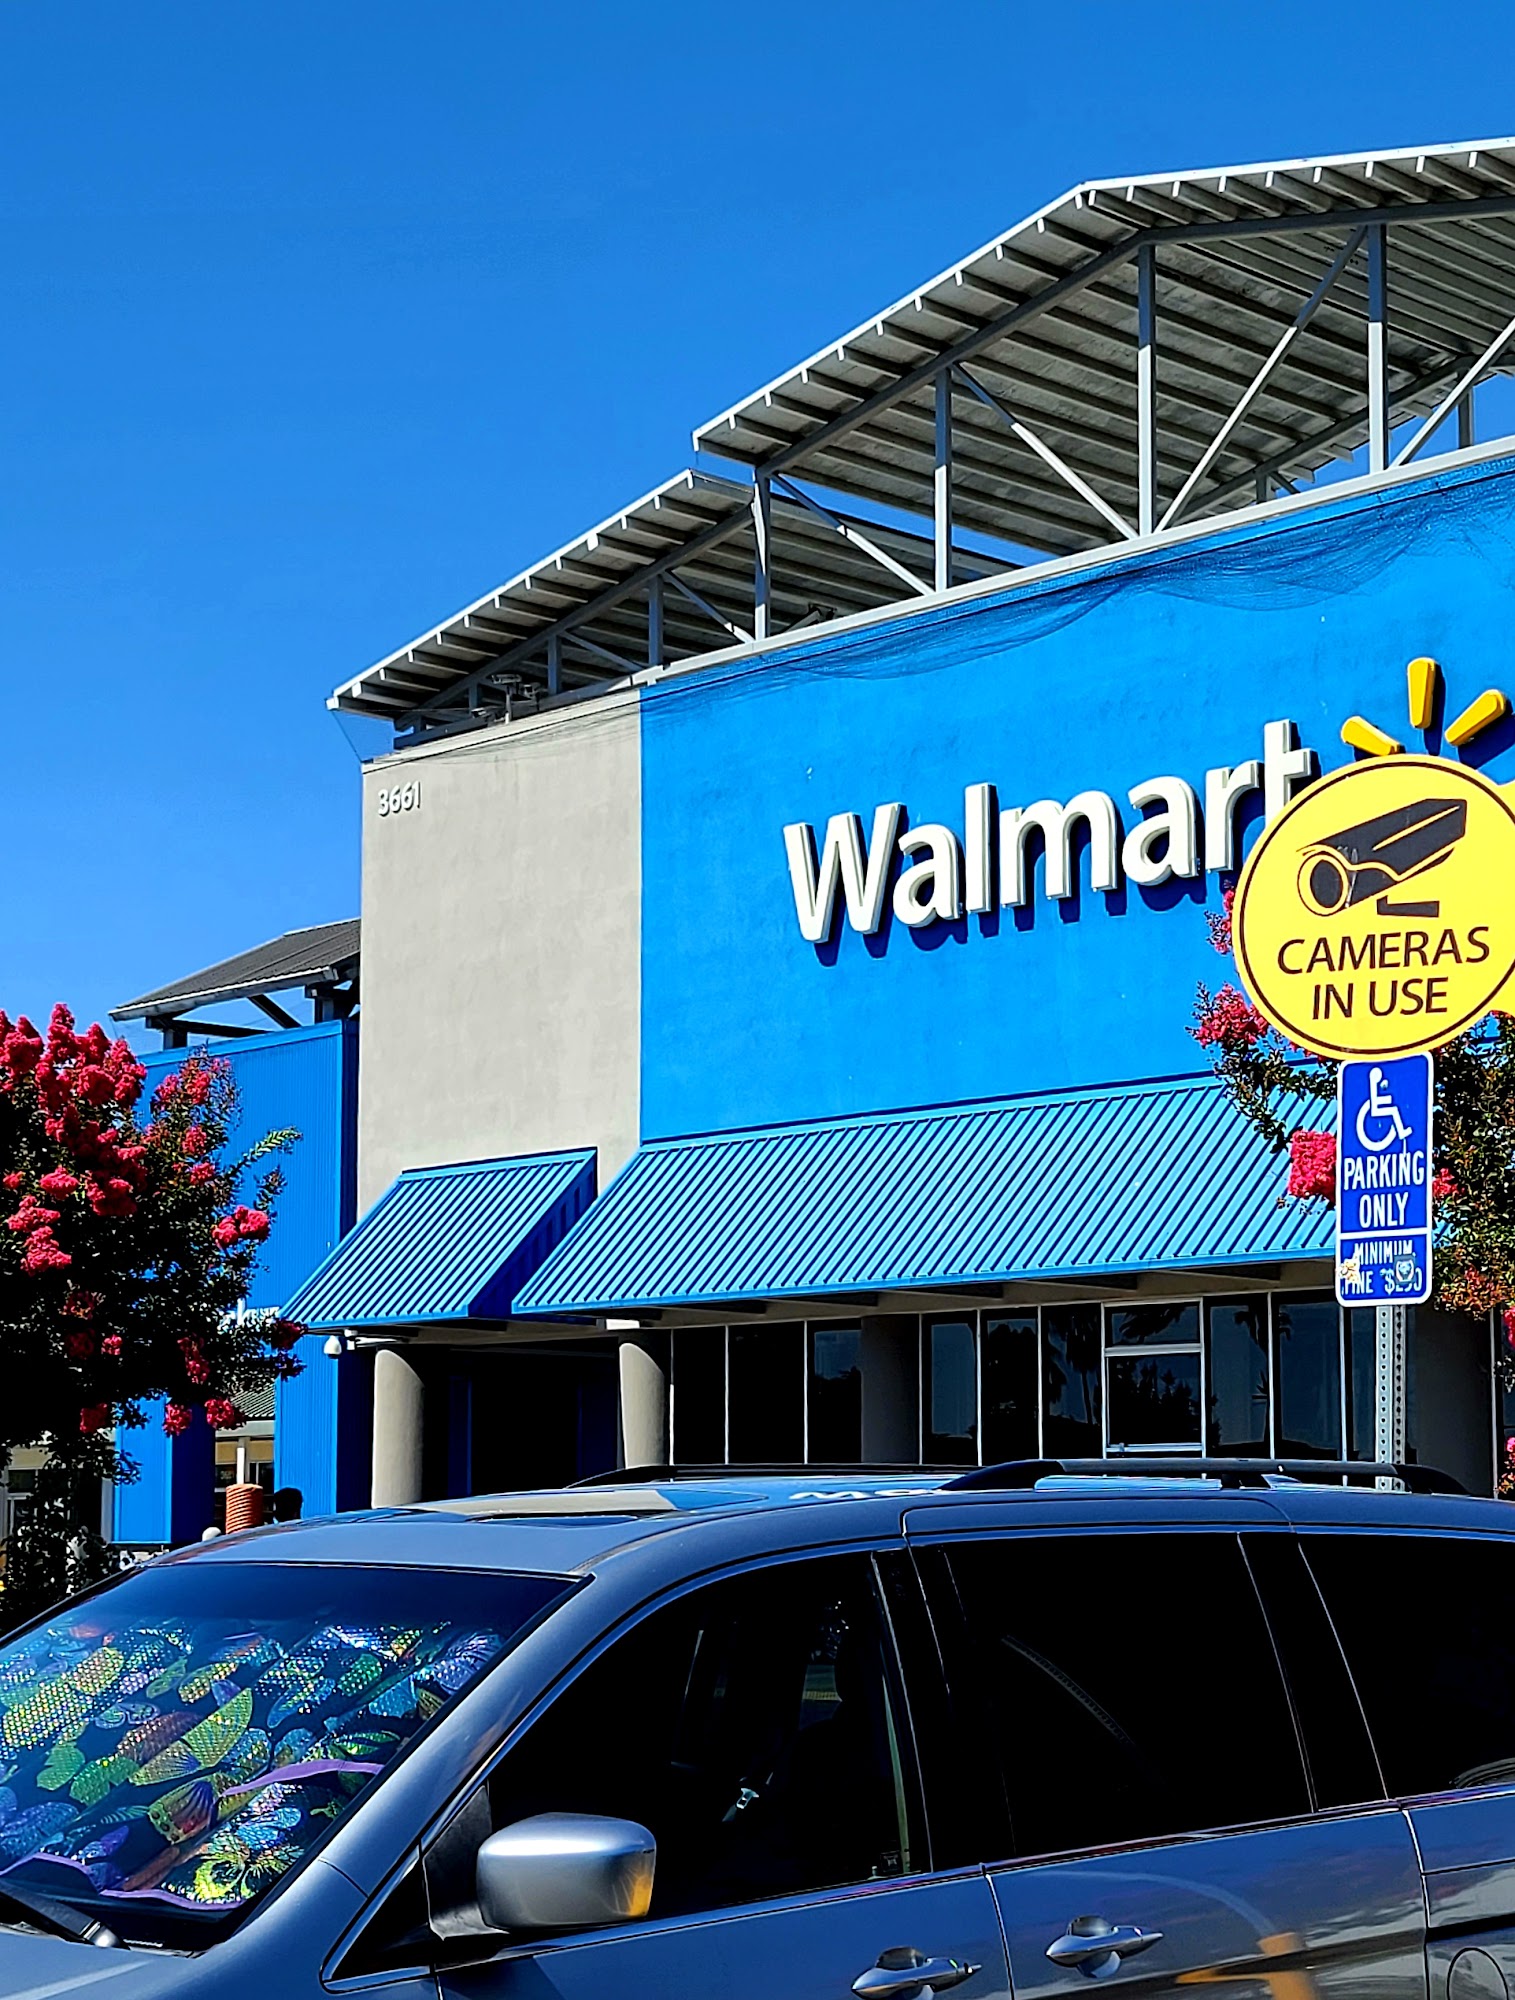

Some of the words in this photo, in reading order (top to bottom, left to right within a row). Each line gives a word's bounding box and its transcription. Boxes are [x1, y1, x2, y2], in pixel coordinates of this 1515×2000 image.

[378, 781, 421, 817] 3661
[784, 719, 1313, 943] Walmart
[1277, 926, 1490, 974] CAMERAS
[1312, 982, 1354, 1020] IN
[1369, 976, 1449, 1016] USE
[1343, 1151, 1425, 1190] PARKING
[1359, 1192, 1408, 1228] ONLY
[1384, 1267, 1423, 1296] $0
